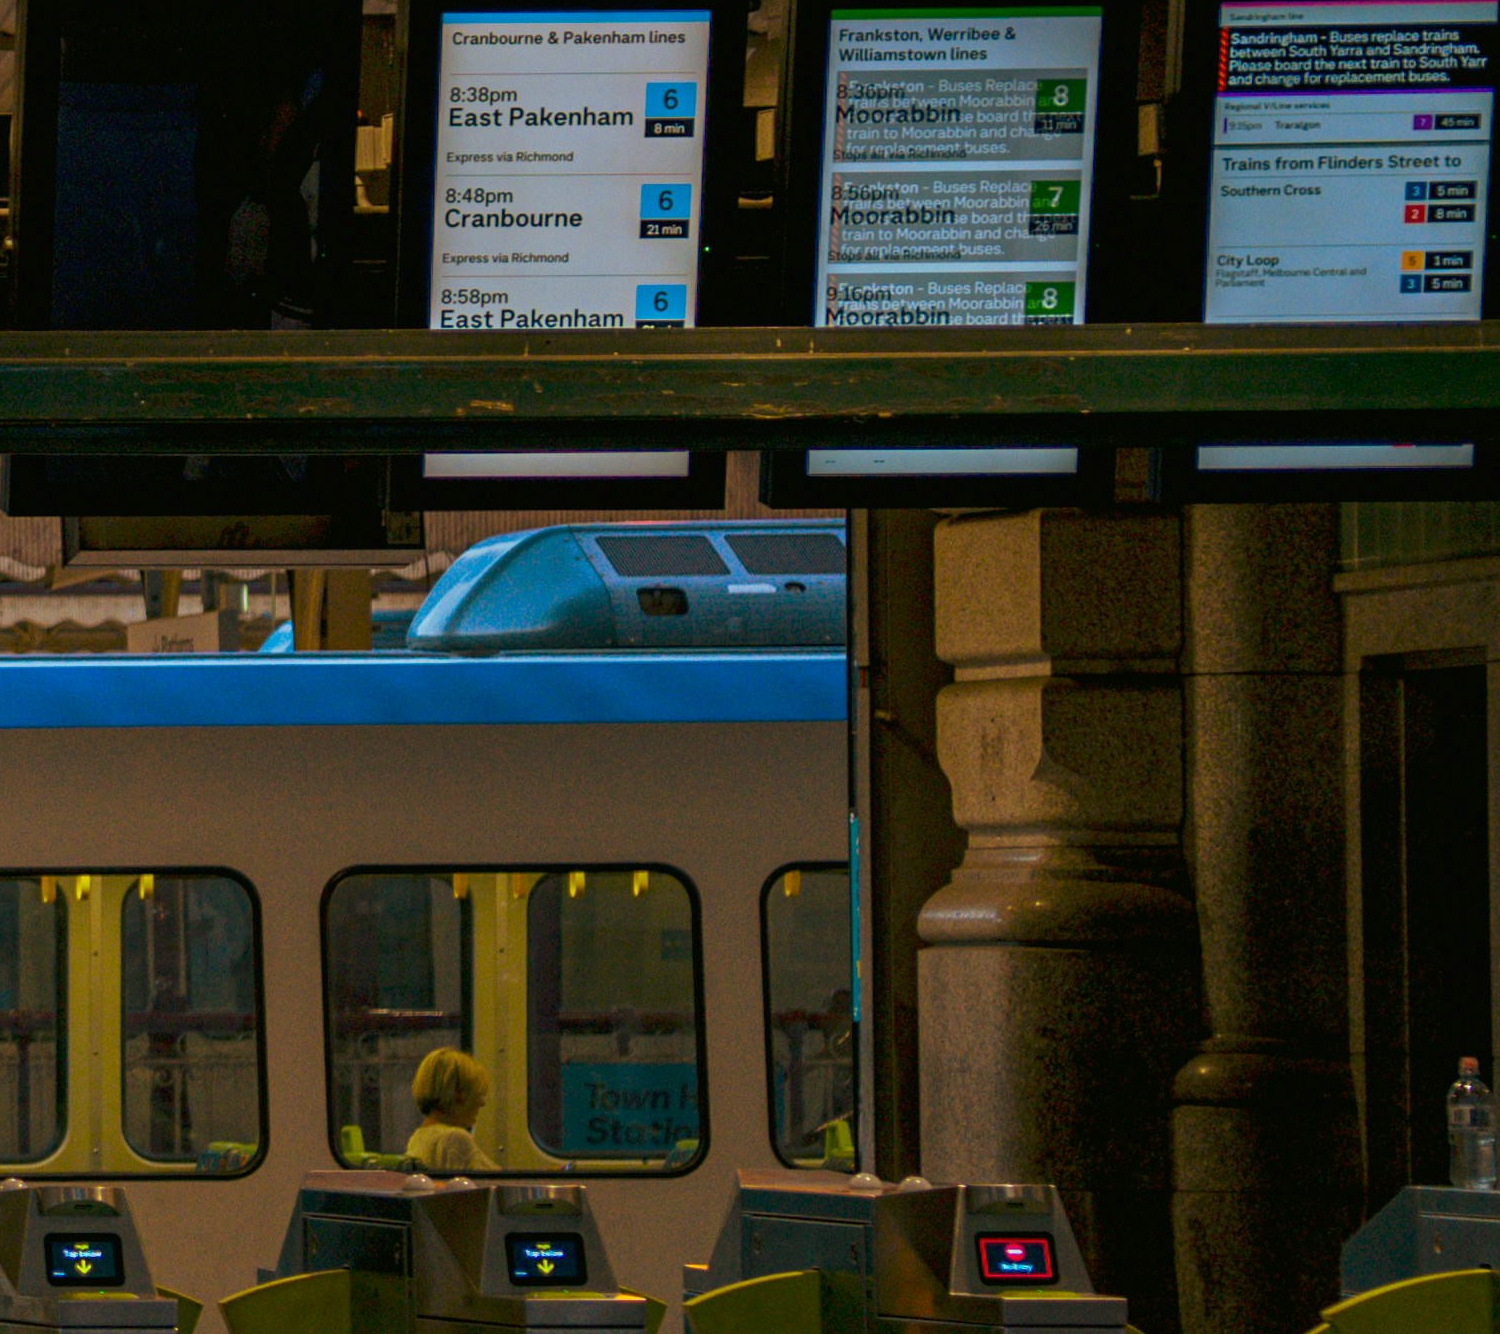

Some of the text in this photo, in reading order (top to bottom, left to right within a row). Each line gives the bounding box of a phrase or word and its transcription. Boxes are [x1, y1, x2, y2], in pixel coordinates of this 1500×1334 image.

[452, 31, 685, 45] Cranbourne & Pakenham lines
[839, 27, 1015, 41] Frankston, Werribee &
[1231, 30, 1459, 46] Sandringham Buses replace trains
[839, 49, 987, 61] Williamstown lines
[1230, 45, 1389, 57] between South Yarra and
[1274, 59, 1311, 70] board
[1314, 59, 1335, 70] the
[1338, 59, 1367, 69] next
[1370, 58, 1400, 69] train
[1403, 58, 1414, 68] to
[1417, 57, 1457, 68] South
[1228, 73, 1321, 85] and for
[450, 87, 517, 105] 8:38pm
[664, 89, 678, 109] 6
[449, 107, 633, 126] East Pakenham
[836, 105, 961, 124] Moorabbin
[664, 123, 684, 133] min
[447, 152, 573, 163] Express via Richmond
[1223, 155, 1461, 171] Trains from Flinders Street to
[446, 188, 513, 206] 8:48pm
[1221, 185, 1321, 196] Southern Cross
[1447, 186, 1468, 195] min
[658, 190, 672, 211] 6
[445, 209, 582, 227] Cranbourne
[830, 206, 956, 225] Moorabbin
[1446, 209, 1467, 218] min
[662, 224, 682, 234] min
[443, 253, 569, 264] Express via Richmond
[1217, 255, 1278, 267] City Loop
[1442, 256, 1463, 265] min
[1442, 279, 1462, 288] min
[441, 289, 508, 307] 8:58pm
[654, 291, 668, 311] 6
[441, 309, 623, 328] East Pakenham
[584, 1082, 669, 1110] Town
[588, 1117, 694, 1145] Statio
